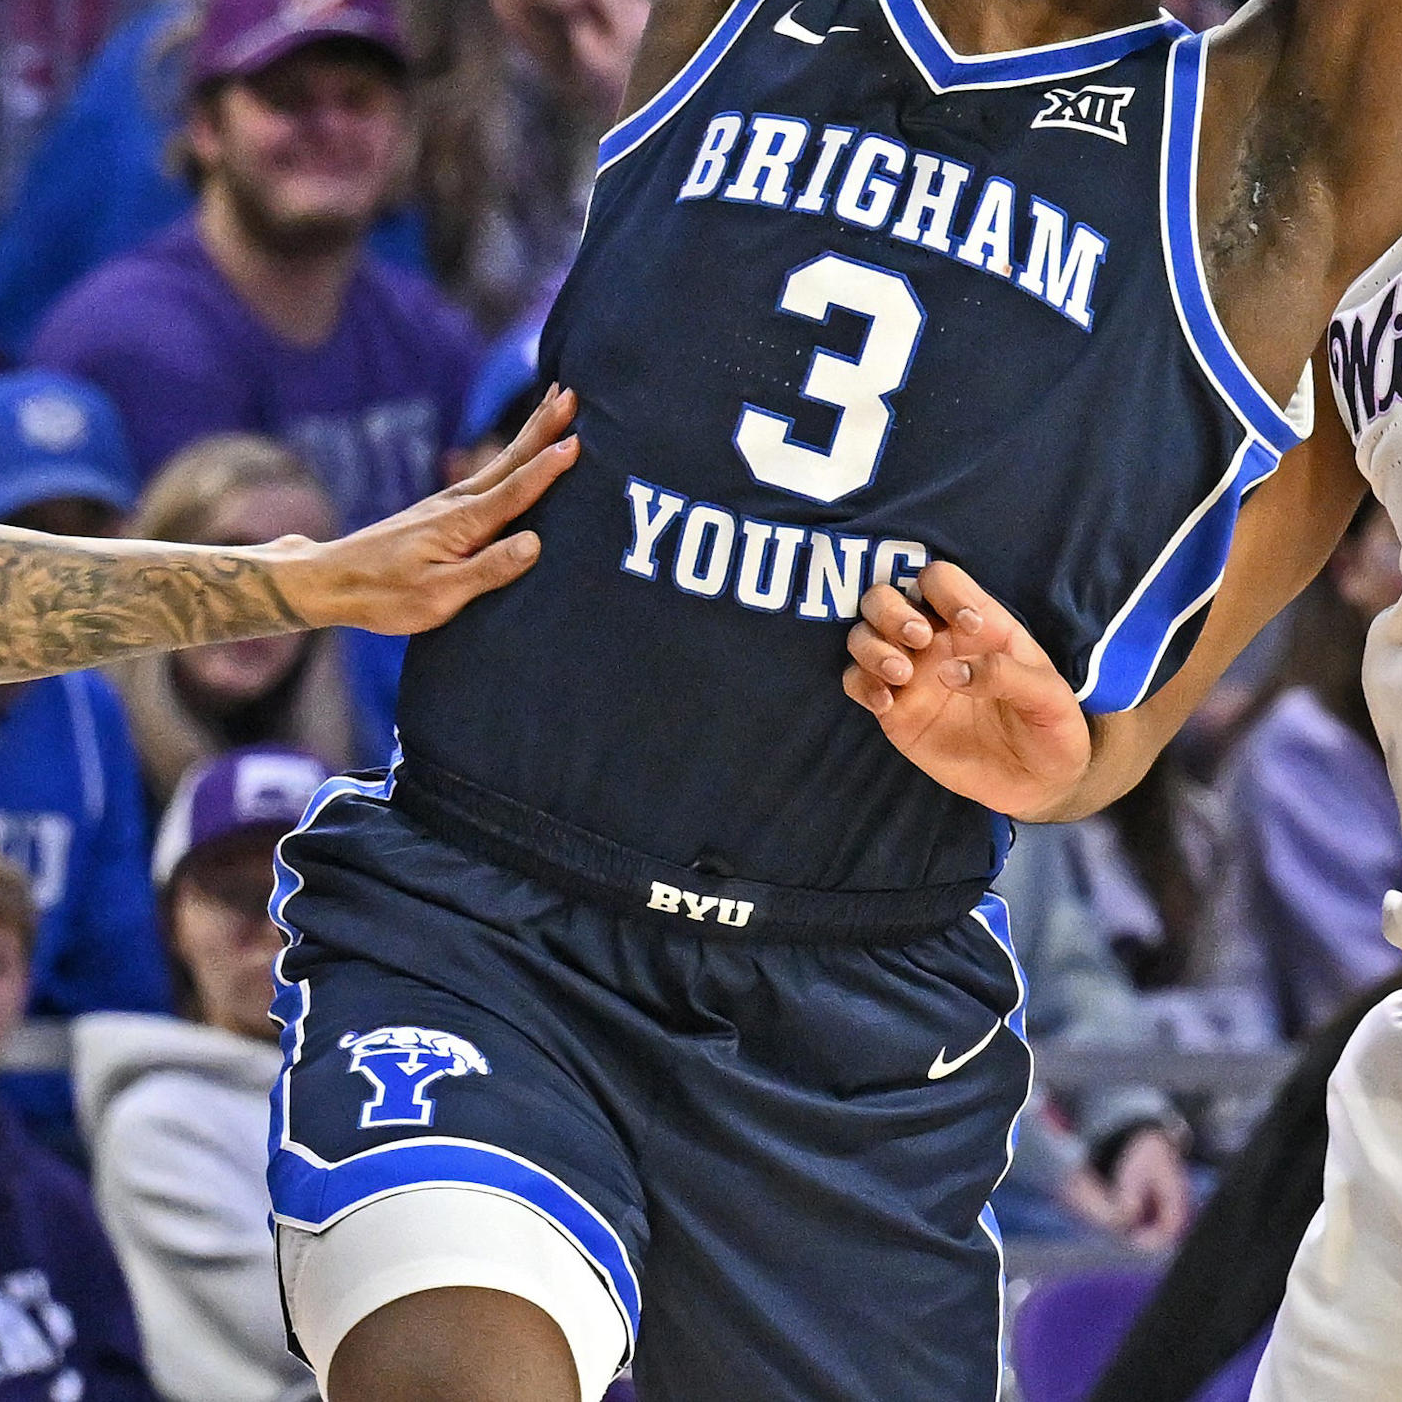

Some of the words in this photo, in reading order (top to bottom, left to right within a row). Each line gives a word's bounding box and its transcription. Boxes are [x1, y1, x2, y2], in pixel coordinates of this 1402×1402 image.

[1033, 87, 1133, 143] XII
[677, 111, 1109, 331] BRIGHAM
[732, 252, 927, 505] 3
[621, 476, 932, 622] YOUNG
[646, 880, 755, 928] BYU
[349, 1044, 458, 1128] Y
